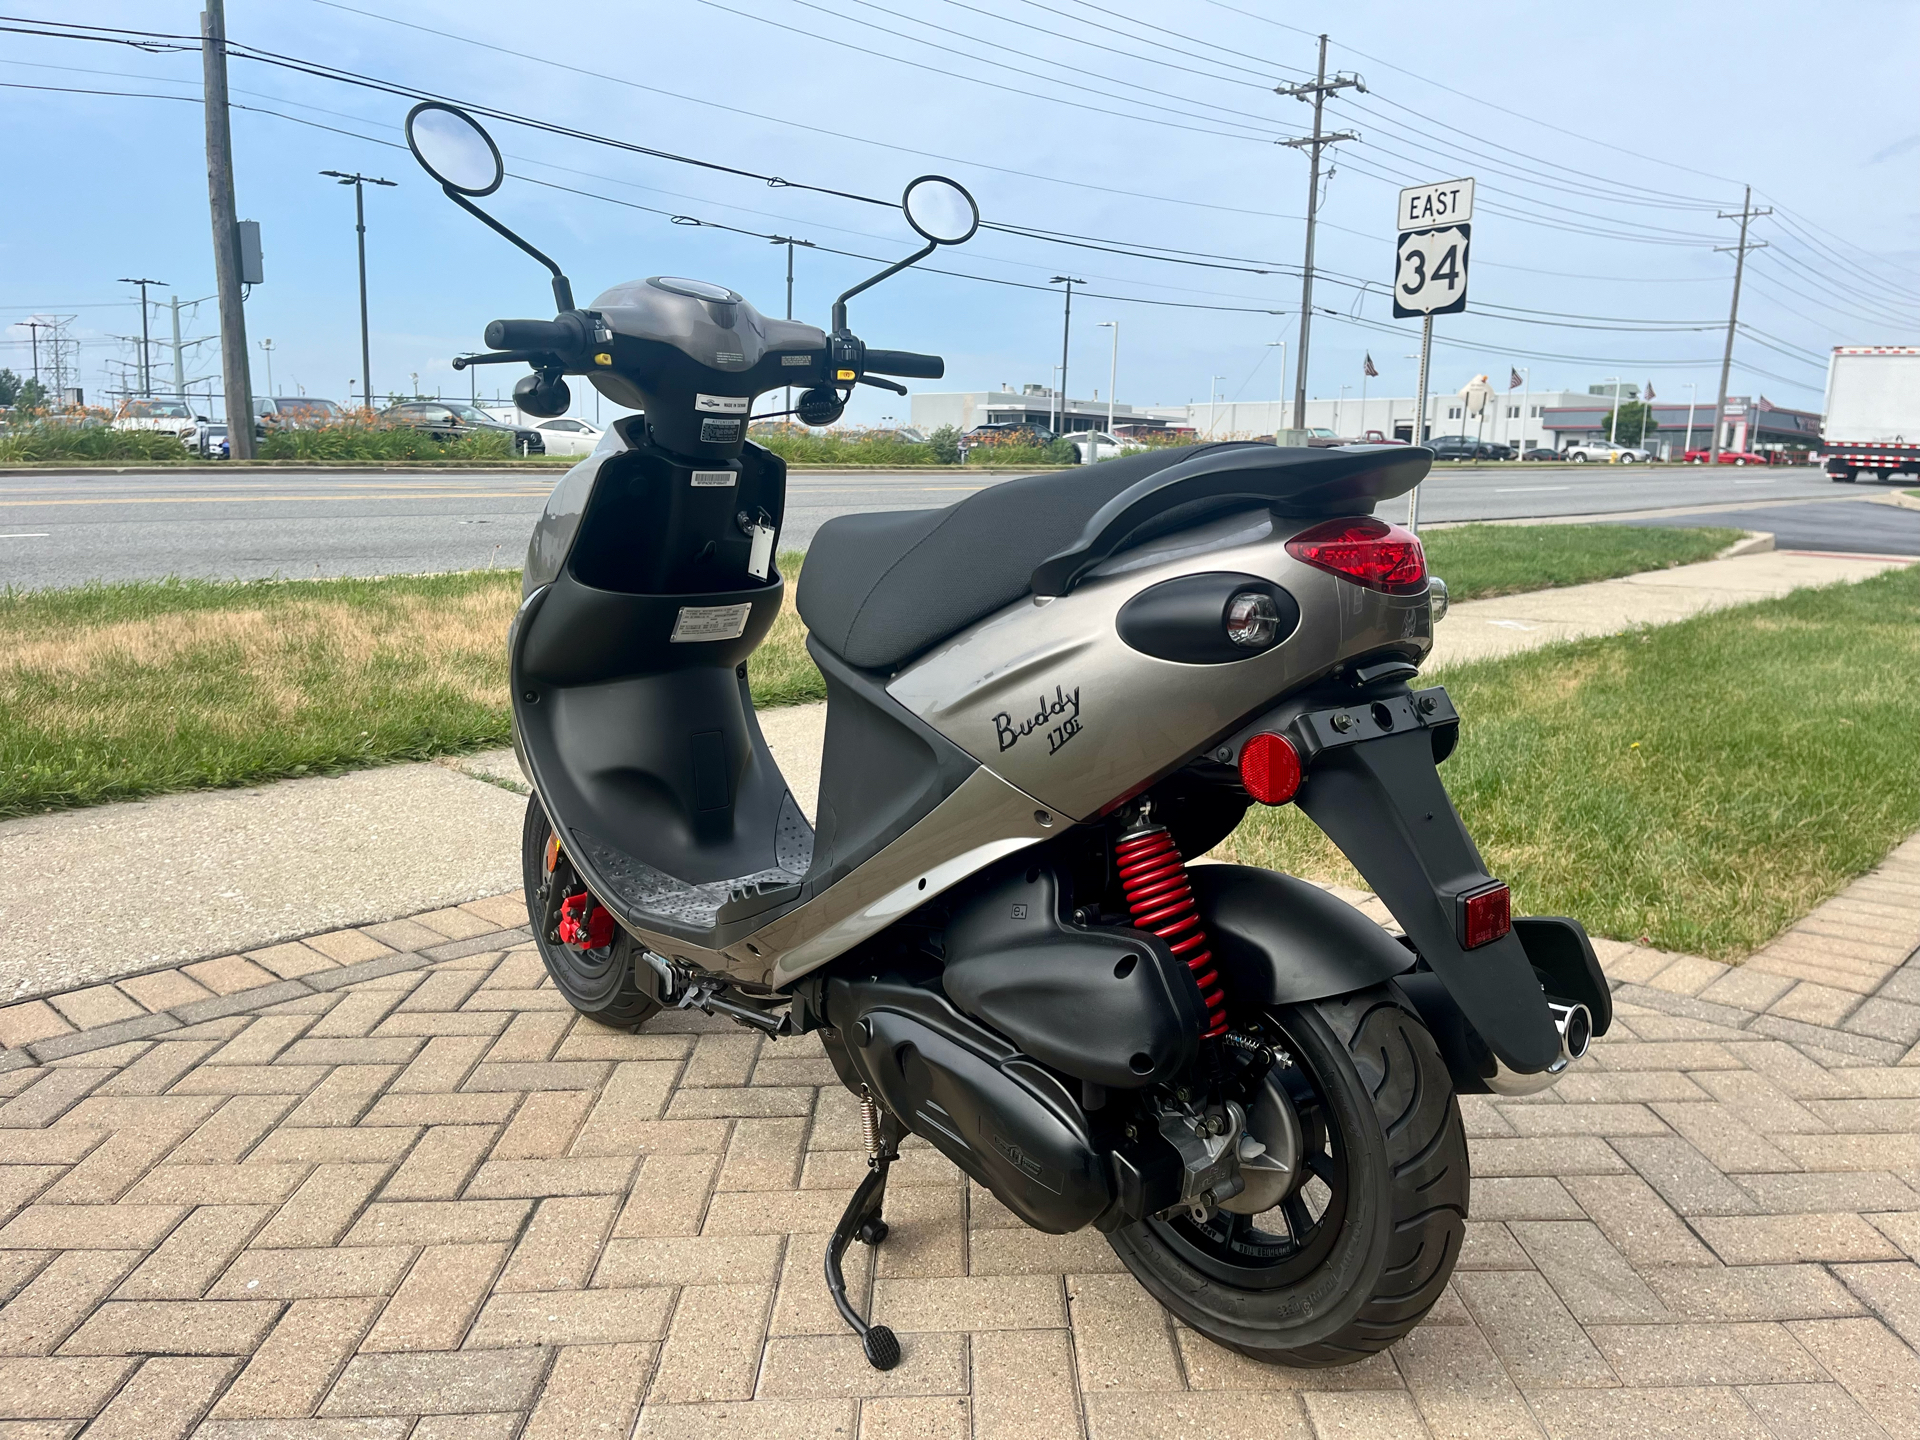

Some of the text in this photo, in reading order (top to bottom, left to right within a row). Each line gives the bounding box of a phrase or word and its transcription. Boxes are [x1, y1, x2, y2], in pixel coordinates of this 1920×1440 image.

[1409, 189, 1460, 220] EAST
[1402, 244, 1459, 295] 34
[991, 684, 1079, 753] Buddy
[1047, 719, 1083, 756] 170i
